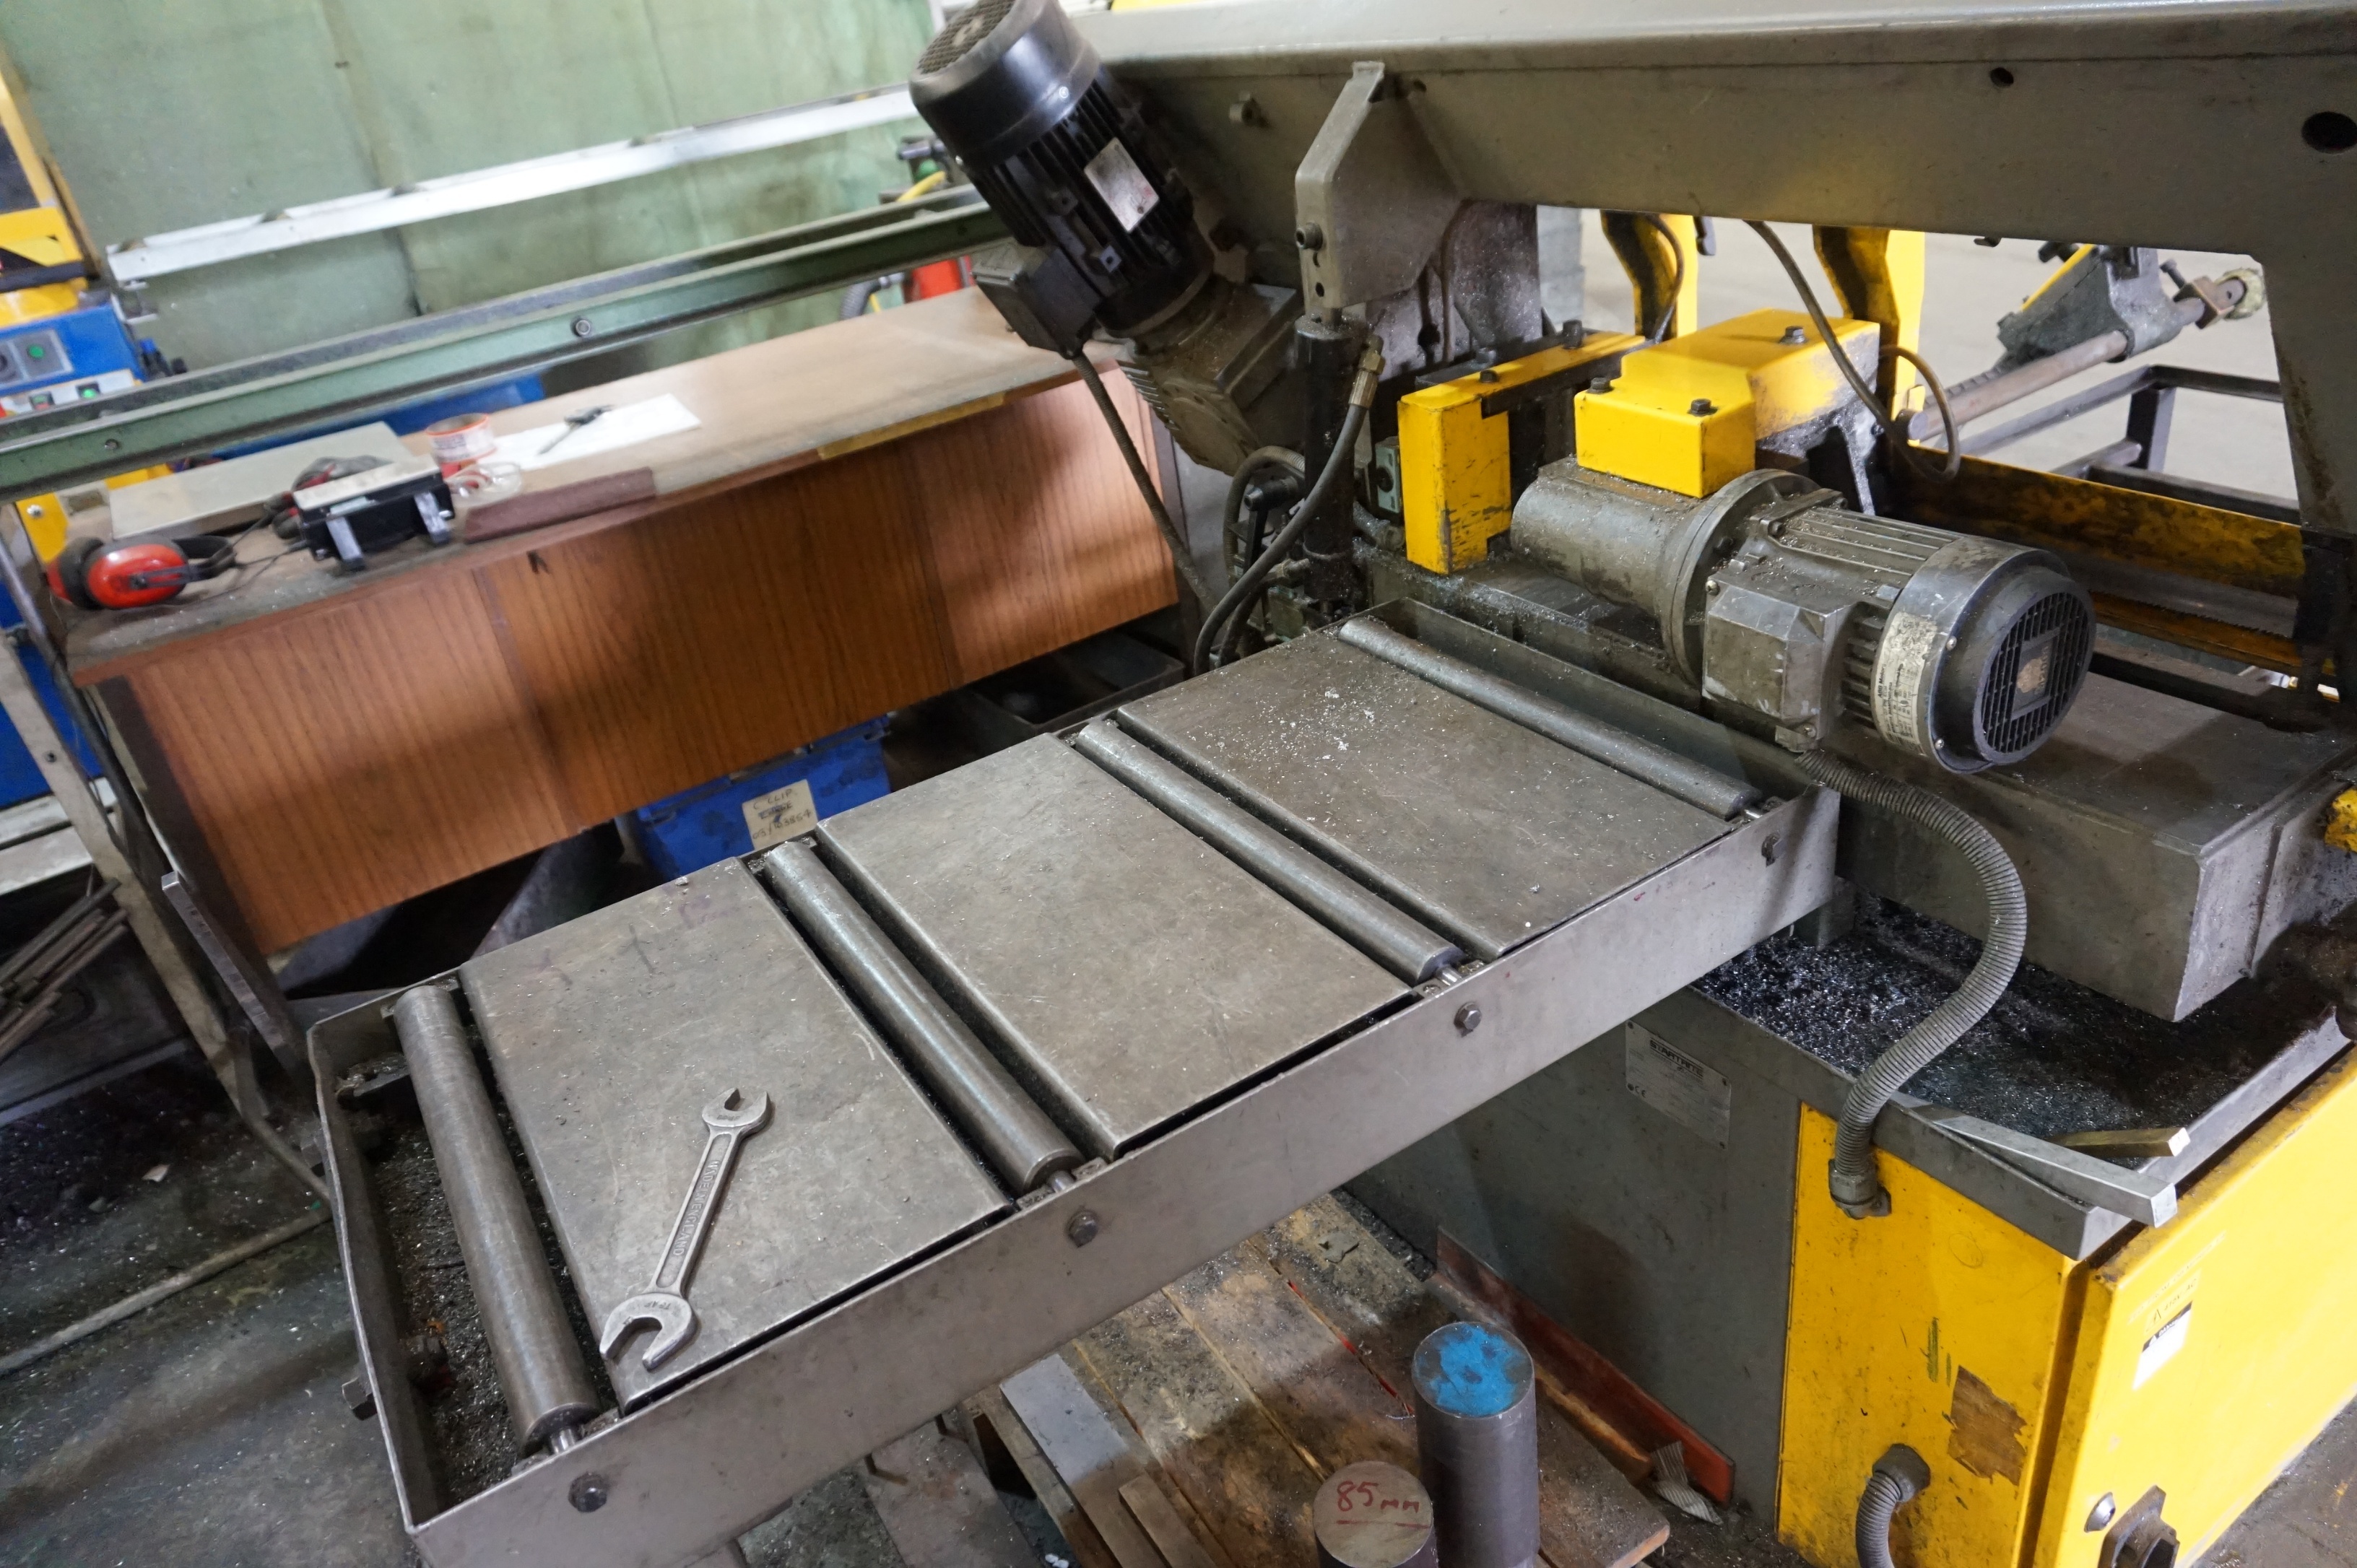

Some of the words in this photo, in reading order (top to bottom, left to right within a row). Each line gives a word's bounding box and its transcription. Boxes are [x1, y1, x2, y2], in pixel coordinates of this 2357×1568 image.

[1649, 1039, 1703, 1078] STARTRITE
[699, 1160, 720, 1190] MADE
[672, 1201, 703, 1256] ENGLAND
